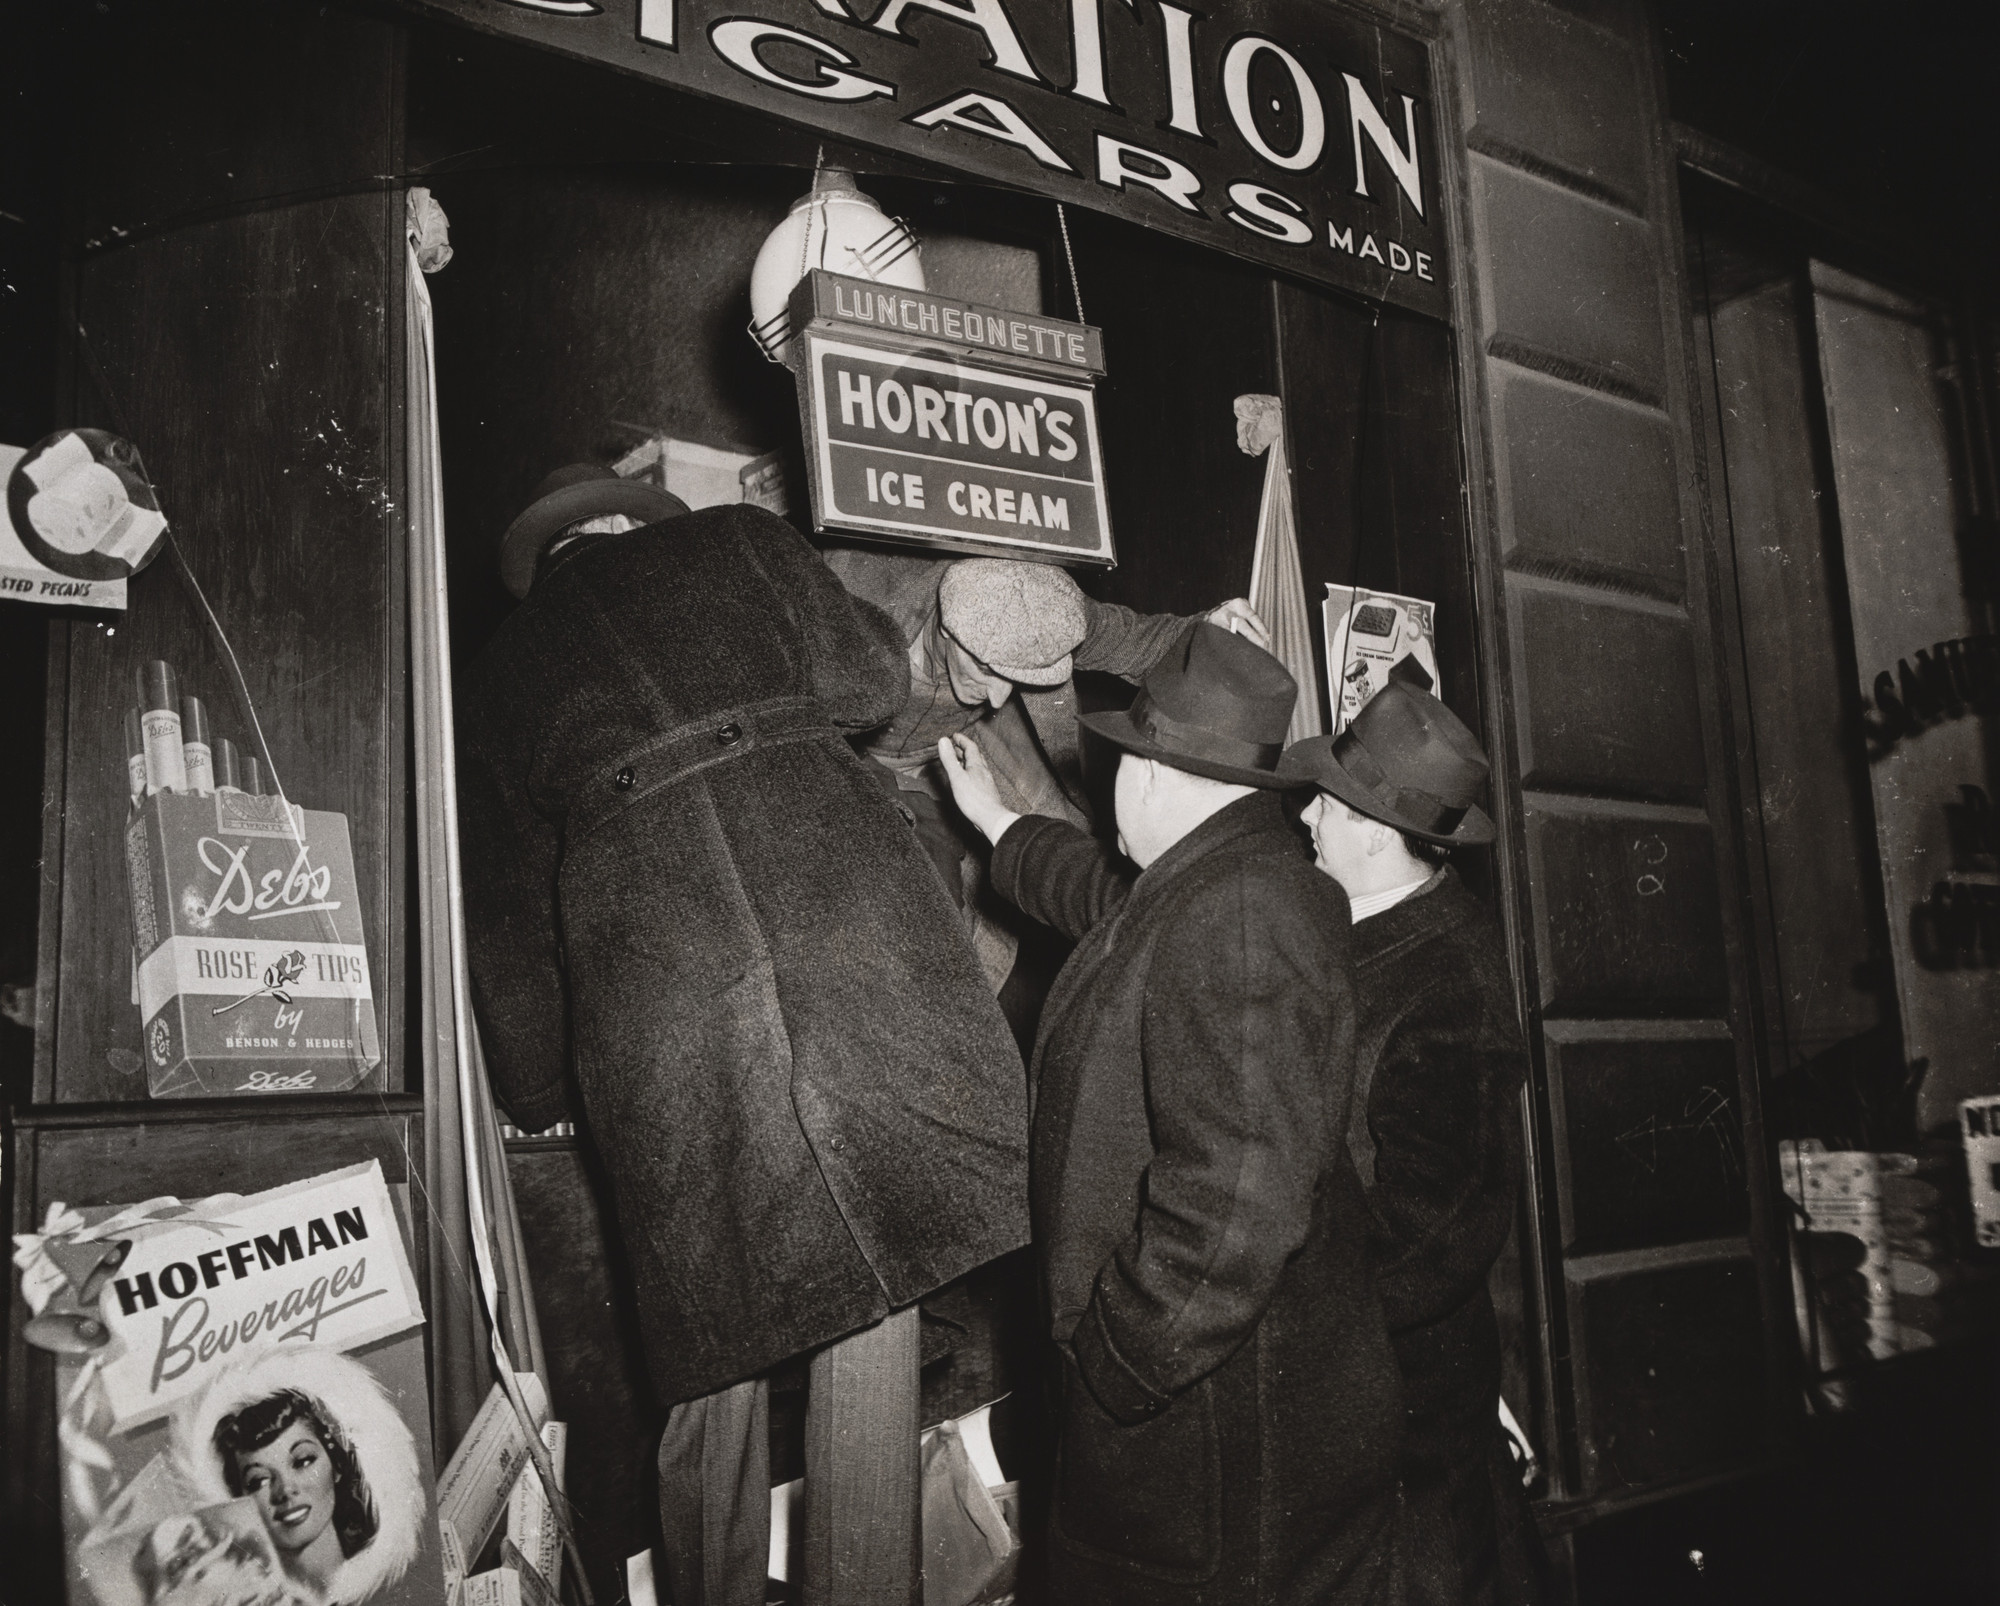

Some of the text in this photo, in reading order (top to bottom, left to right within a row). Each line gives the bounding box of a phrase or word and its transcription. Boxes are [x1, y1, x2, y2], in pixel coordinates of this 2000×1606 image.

[500, 0, 1314, 244] IGARS
[815, 0, 1424, 219] ATION
[1327, 220, 1434, 282] MADE
[835, 285, 1087, 363] LUNCHEONETTE
[837, 370, 1078, 462] HORTON'S
[865, 467, 1071, 531] ICE CREAM
[39, 579, 92, 598] PECANS
[195, 948, 363, 984] ROSE TIPS
[225, 1037, 354, 1049] BENSON & HEDGES
[274, 1004, 304, 1036] by
[113, 1206, 369, 1316] HOFFMAN
[151, 1256, 368, 1394] Beverages
